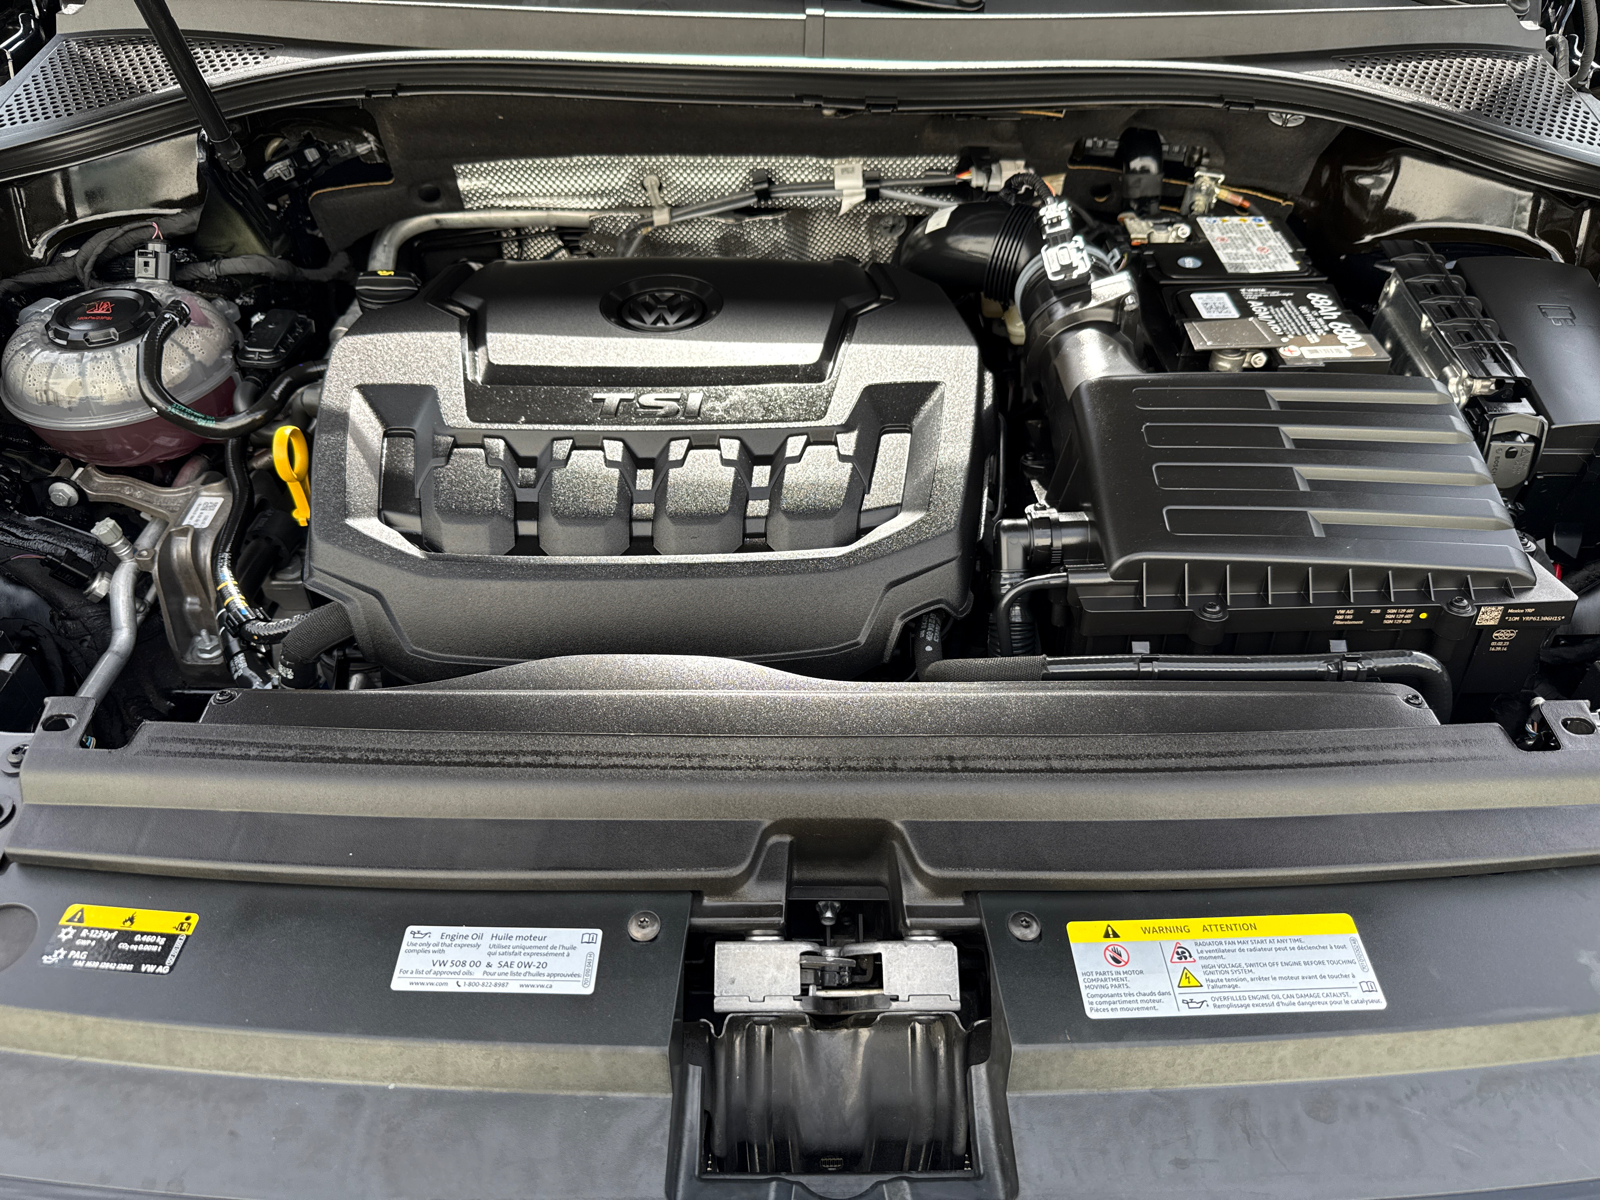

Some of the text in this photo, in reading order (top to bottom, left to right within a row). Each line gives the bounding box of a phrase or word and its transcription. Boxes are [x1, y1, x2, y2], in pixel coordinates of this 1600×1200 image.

[1328, 322, 1367, 350] 680A
[592, 392, 704, 419] TSI
[1492, 456, 1500, 475] BOSCH
[1140, 922, 1257, 935] WARNING ATTENTION
[80, 929, 118, 941] R-1234yf
[156, 935, 166, 945] kg
[440, 932, 469, 941] Engine
[68, 950, 88, 960] PAG
[141, 964, 170, 974] VW AG
